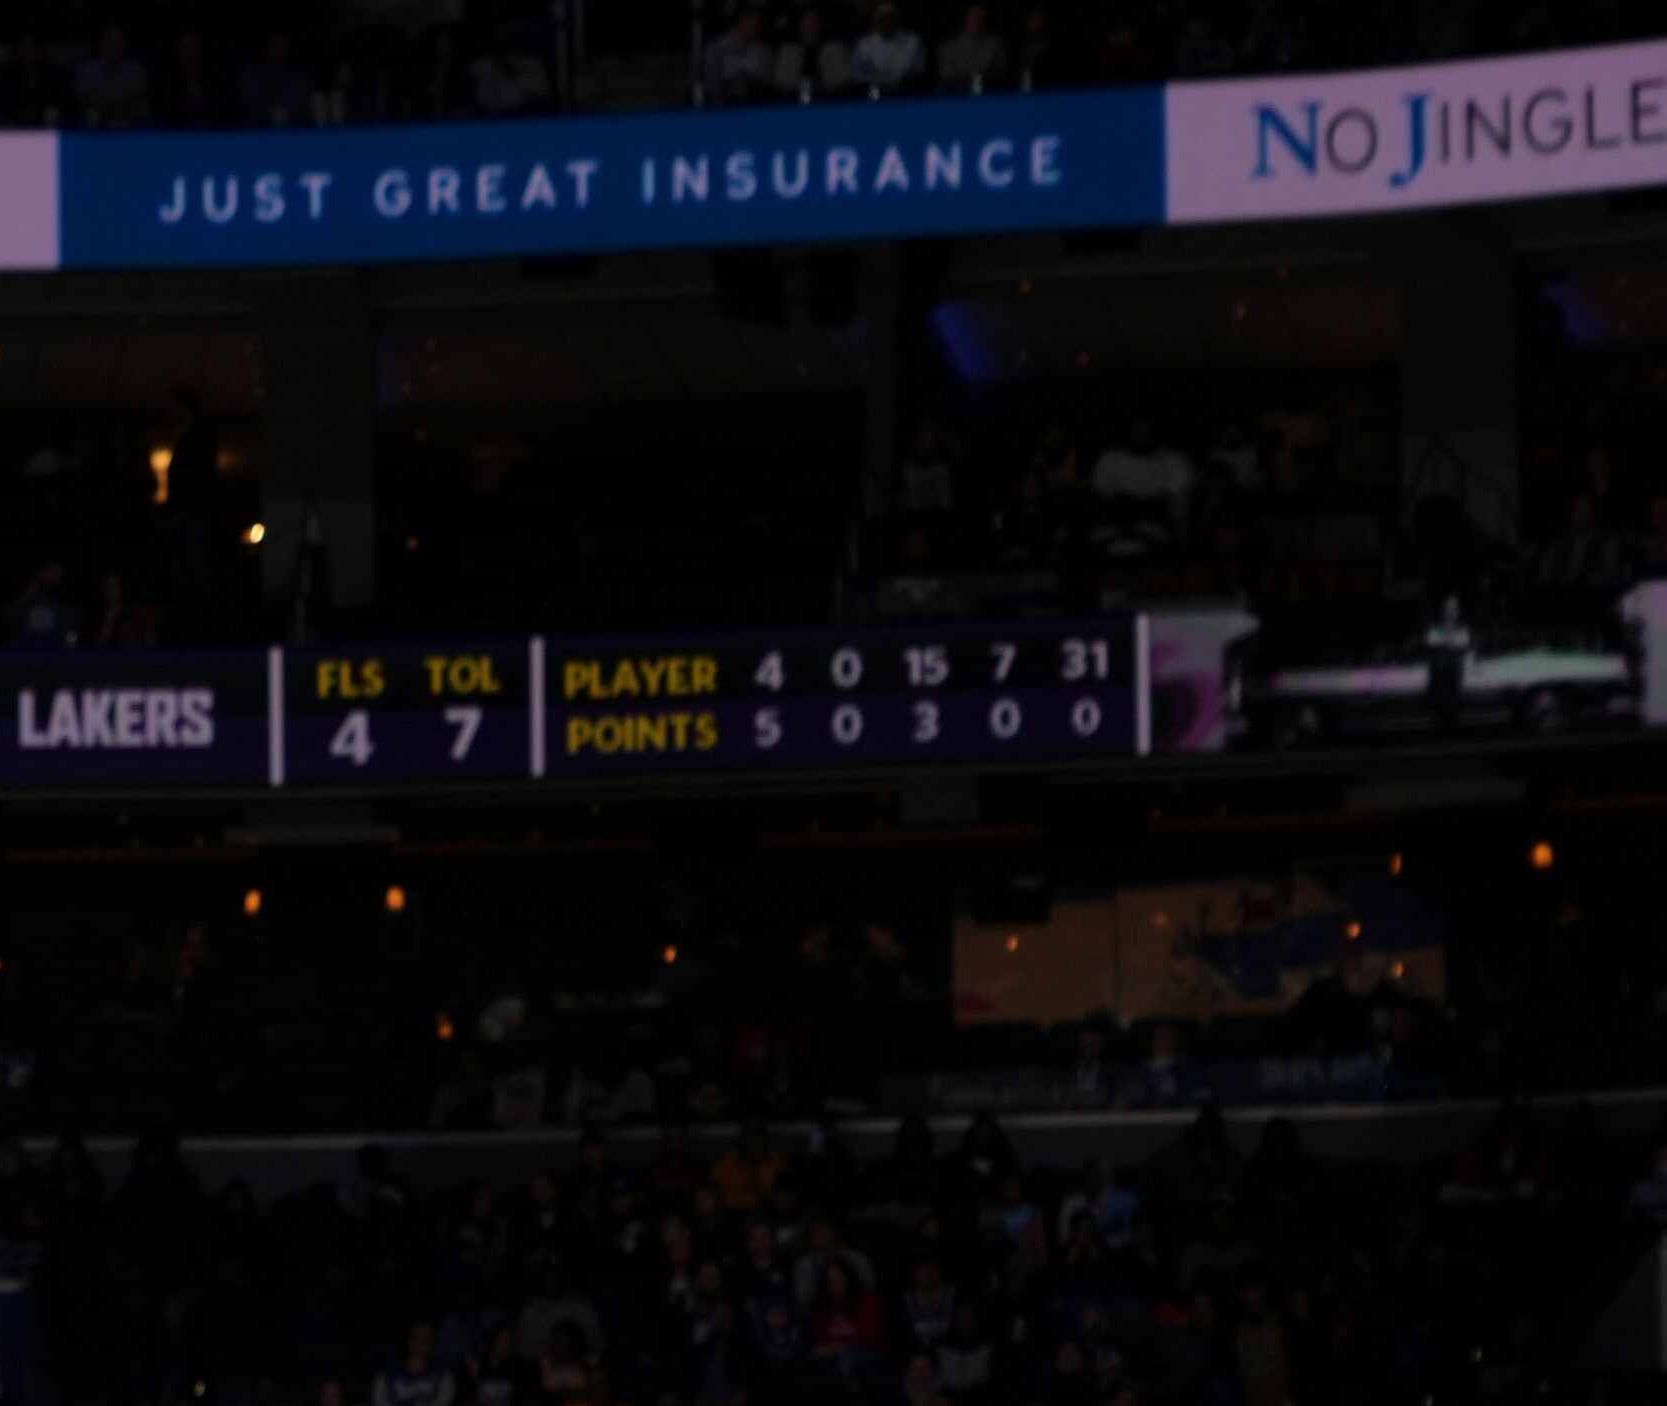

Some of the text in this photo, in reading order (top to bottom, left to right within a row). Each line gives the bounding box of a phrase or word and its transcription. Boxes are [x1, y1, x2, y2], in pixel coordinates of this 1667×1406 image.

[1248, 100, 1377, 180] NO
[161, 137, 1065, 225] JUST GREAT INSURANCE
[317, 655, 500, 699] FLS TOL
[563, 639, 1108, 699] PLAYER 4 0 15 7 31
[18, 687, 215, 749] LAKERS
[330, 707, 483, 766] 4 7
[566, 695, 1100, 755] POINTS 5 0 3 0 0
